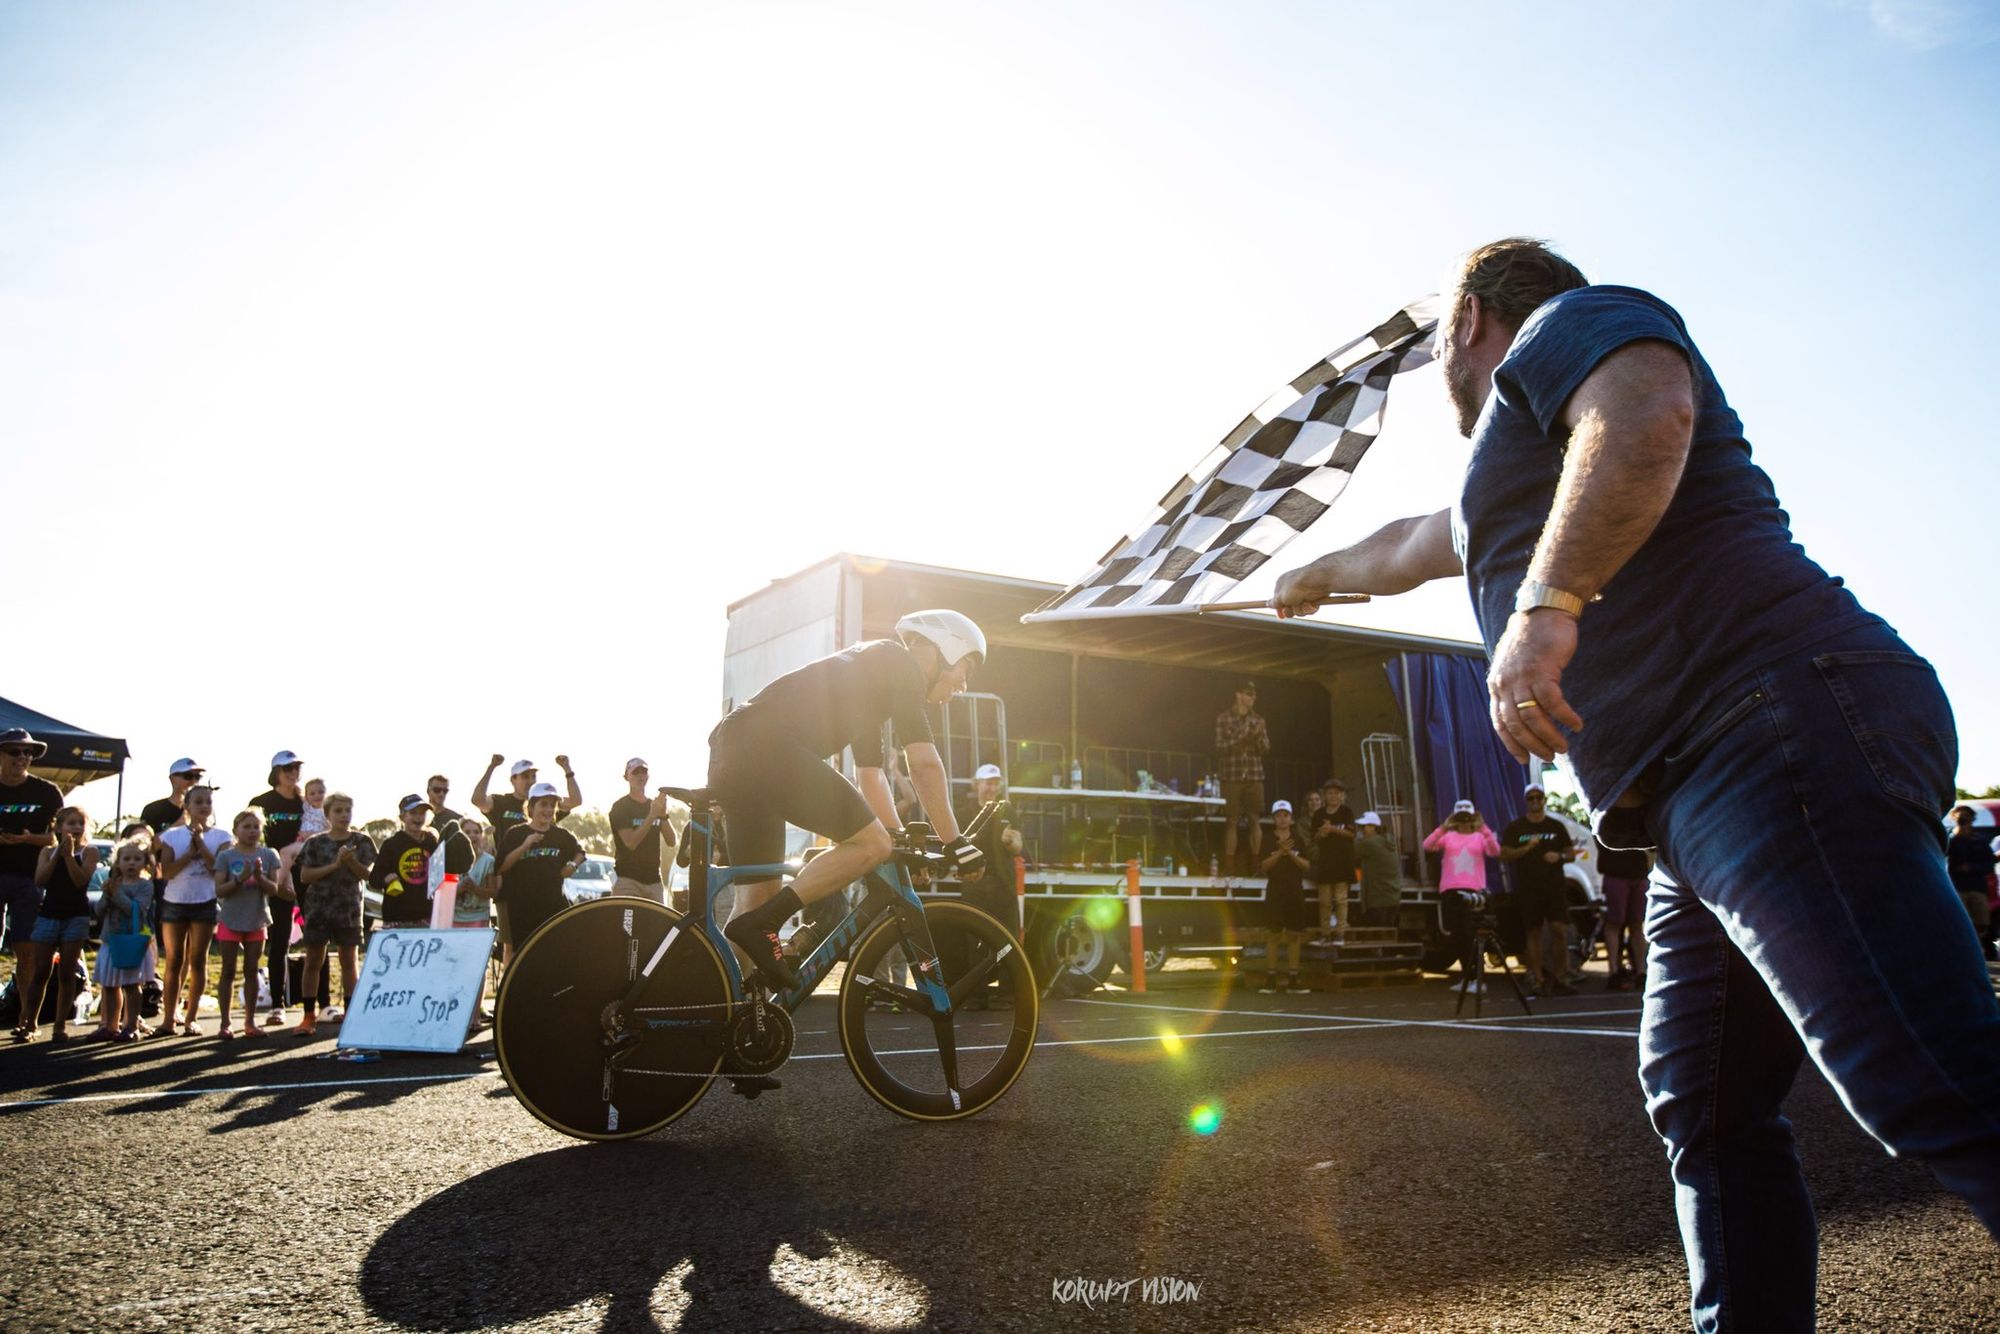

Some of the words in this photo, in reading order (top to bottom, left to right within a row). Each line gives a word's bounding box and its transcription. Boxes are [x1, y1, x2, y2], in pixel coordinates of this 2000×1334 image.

[372, 933, 443, 976] STOP
[363, 983, 416, 1014] FOREST
[417, 995, 459, 1024] STOP
